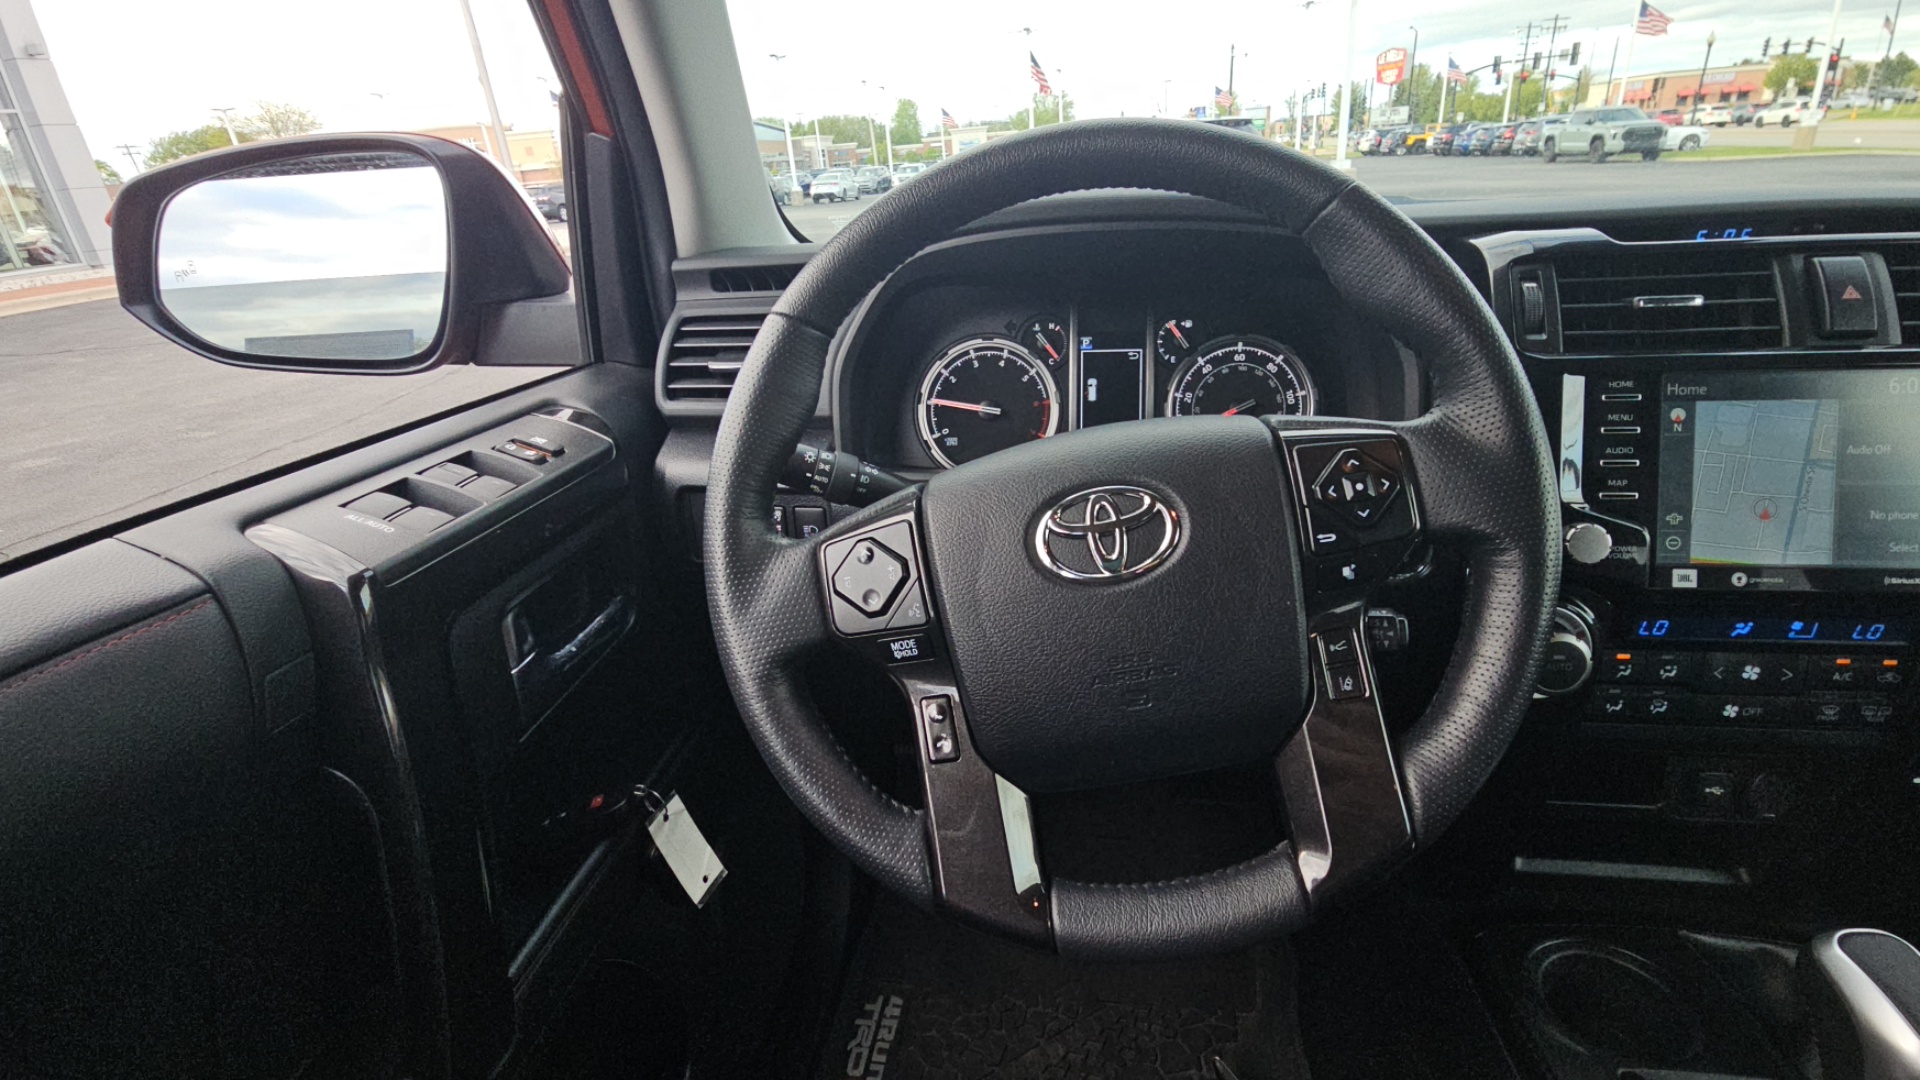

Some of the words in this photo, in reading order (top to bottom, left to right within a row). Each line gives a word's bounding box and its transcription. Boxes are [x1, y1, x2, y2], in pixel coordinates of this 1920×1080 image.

[1233, 353, 1246, 362] 60
[972, 360, 979, 368] 3
[1201, 363, 1213, 375] 40
[1266, 362, 1279, 374] 80
[949, 375, 957, 383] 2
[1021, 374, 1030, 383] 5
[1609, 380, 1634, 388] HOME
[1667, 383, 1708, 396] Home
[1183, 392, 1193, 404] 20
[1285, 389, 1296, 405] 100
[1673, 423, 1682, 432] N
[1846, 444, 1873, 455] Audio
[1875, 444, 1892, 455] Off
[813, 474, 829, 484] AUTO
[1870, 509, 1886, 520] No
[1888, 510, 1919, 522] phone
[343, 514, 365, 523] ALL
[364, 520, 396, 533] AUTO
[1889, 541, 1919, 553] Select
[890, 638, 917, 651] MODE
[901, 648, 918, 658] HOLD
[1833, 672, 1854, 682] A/C
[1742, 707, 1763, 717] OFF
[846, 995, 884, 1077] TRD
